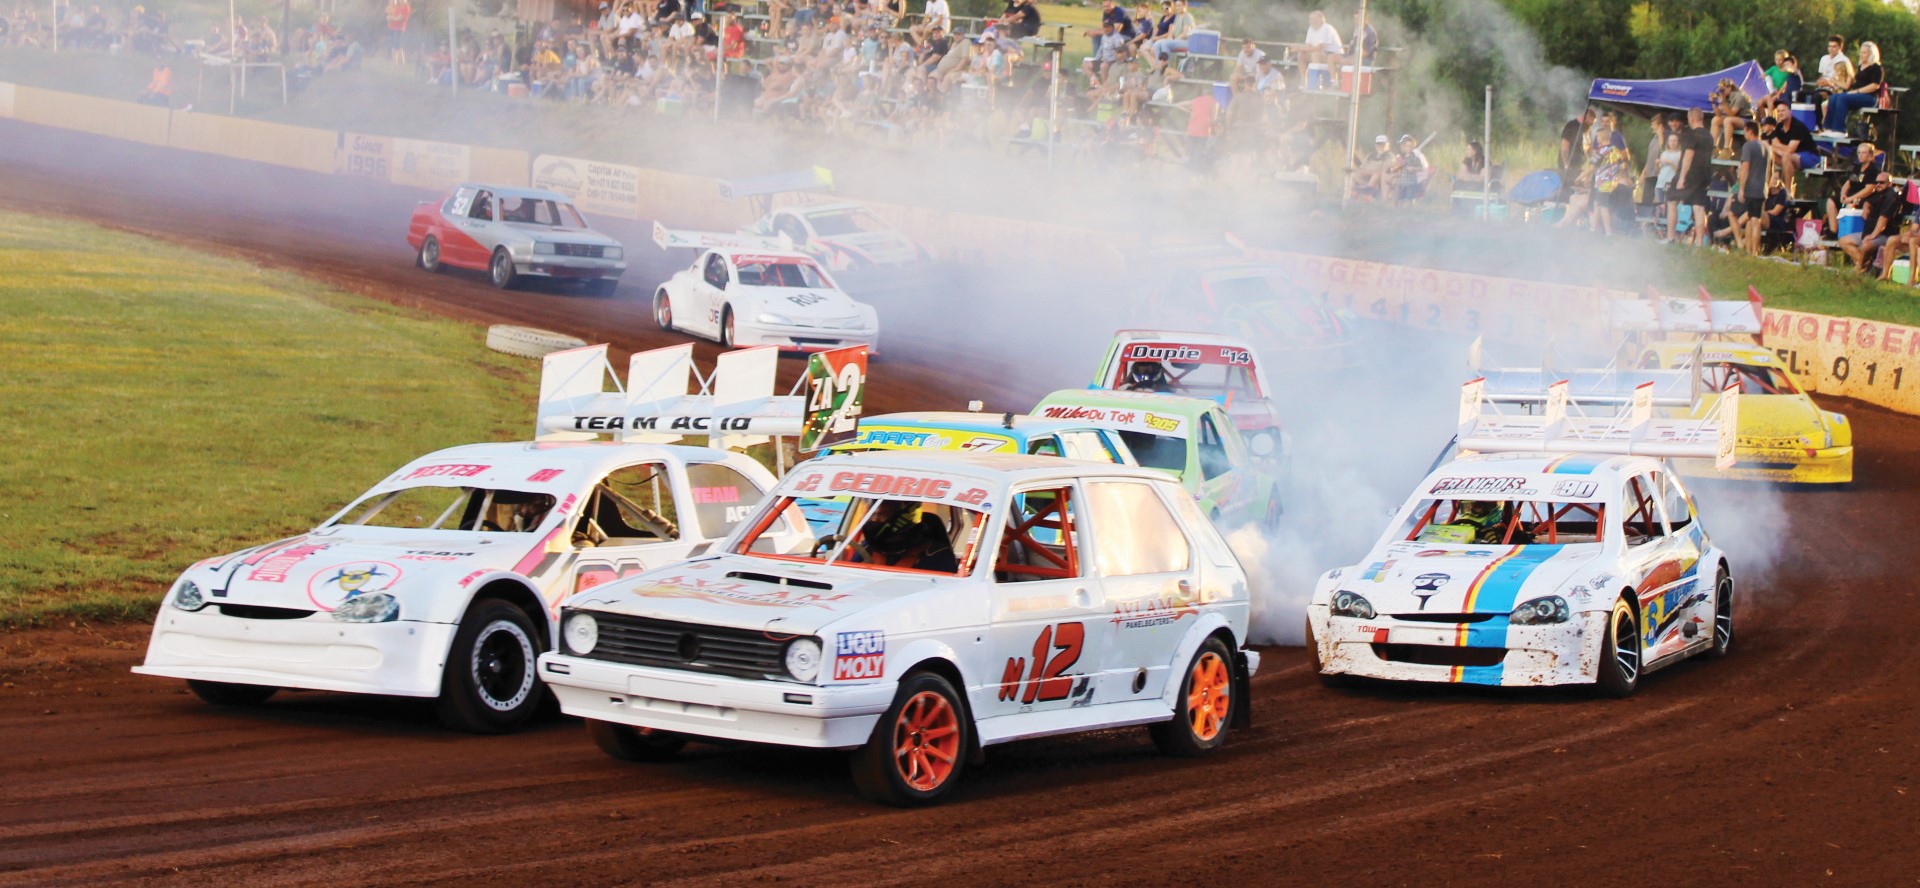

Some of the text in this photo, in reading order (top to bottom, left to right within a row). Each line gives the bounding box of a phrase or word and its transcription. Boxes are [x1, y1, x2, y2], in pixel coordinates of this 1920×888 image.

[347, 153, 387, 177] 1996
[1280, 256, 1490, 300] ORGENROOD
[1132, 346, 1200, 361] Dupie
[809, 362, 862, 435] ZA 2
[574, 416, 657, 430] TEAM
[691, 485, 739, 503] TEAM
[828, 471, 953, 499] CEDRIC
[1429, 477, 1526, 494] FRANCOIS
[836, 632, 884, 655] LIQUI
[834, 655, 884, 679] MOLY
